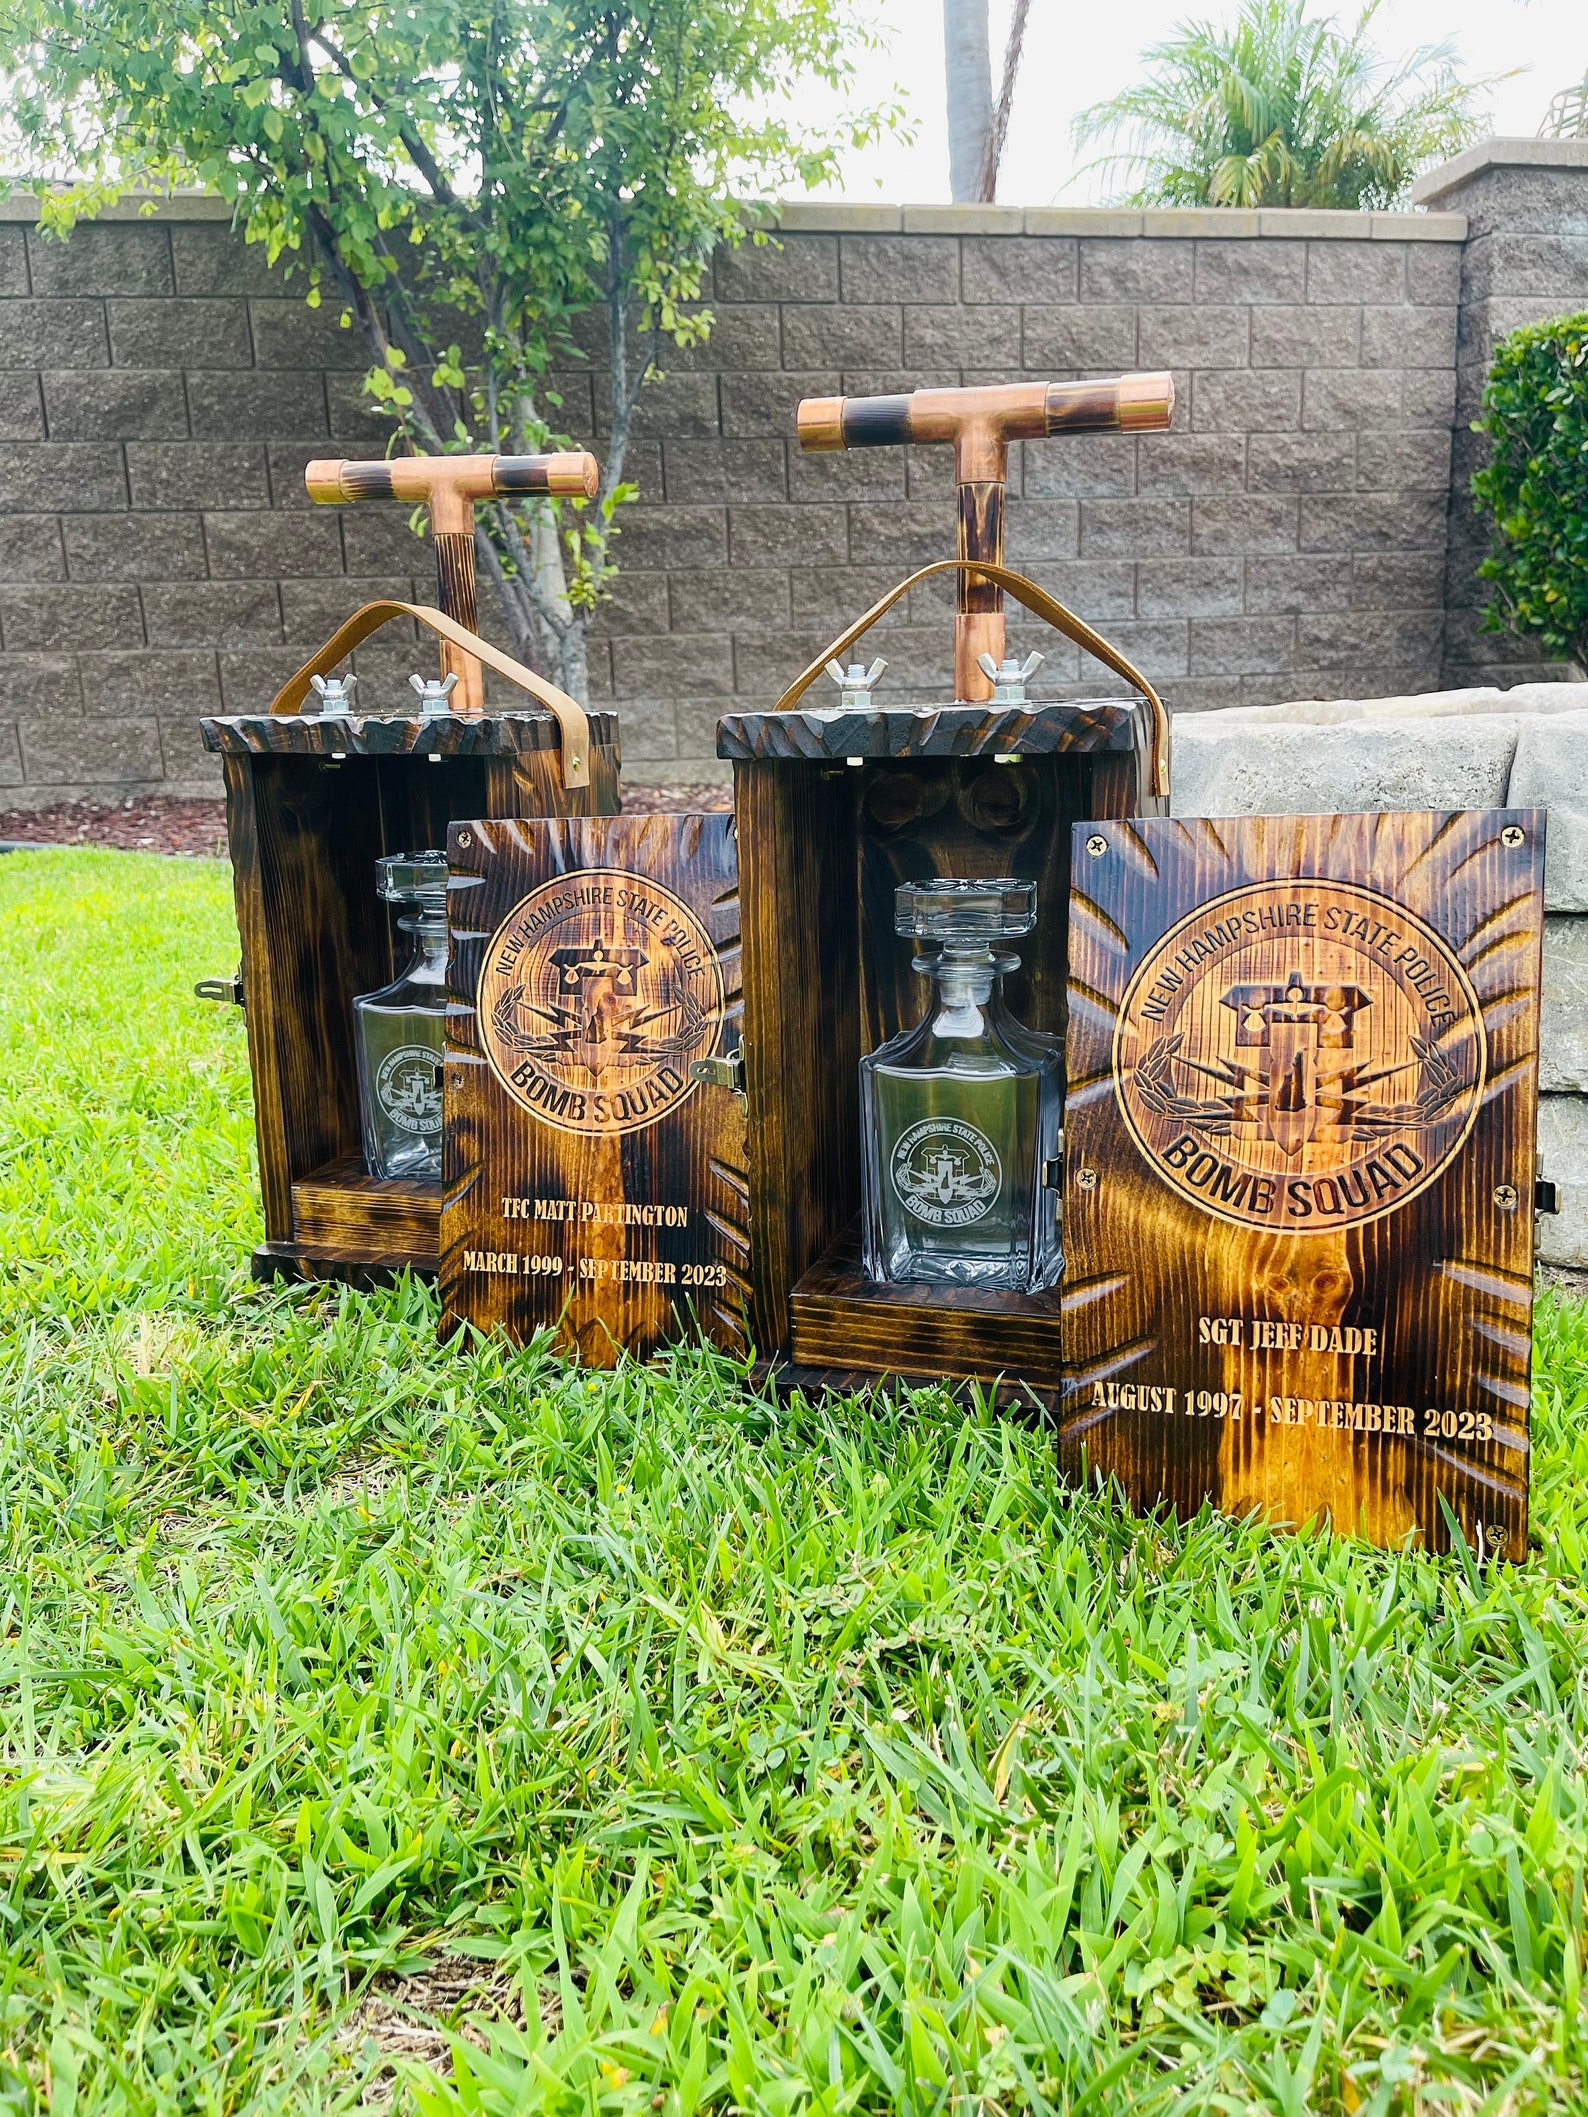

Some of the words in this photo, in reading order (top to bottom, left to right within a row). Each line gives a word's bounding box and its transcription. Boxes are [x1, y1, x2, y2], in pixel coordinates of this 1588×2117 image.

[496, 932, 526, 976] NEW
[522, 887, 613, 939] HAMPSHIRE
[617, 889, 668, 927] STATE
[663, 919, 705, 980] POLICE
[1141, 971, 1183, 1022] NEW
[1180, 903, 1319, 971] HAMPSHIRE
[1324, 906, 1401, 955] STATE
[1393, 946, 1458, 1028] POLICE
[510, 1060, 585, 1121] BOMB
[594, 1066, 685, 1124] SQUAD
[389, 1108, 418, 1130] BOMB
[420, 1114, 443, 1131] SQU
[897, 1142, 911, 1160] NEW
[909, 1123, 952, 1144] HAMPSHIRE
[953, 1124, 977, 1142] STATE
[973, 1138, 995, 1166] POLICE
[1161, 1132, 1279, 1215] BOMB
[1288, 1143, 1424, 1218] SQUAD
[501, 1197, 530, 1219] TFC
[534, 1199, 577, 1222] MATT
[580, 1201, 688, 1228] PARTINGTON
[905, 1195, 942, 1222] BOMB
[944, 1200, 986, 1224] SQUAD
[462, 1250, 518, 1274] MARCH
[522, 1254, 563, 1276] 1999
[579, 1258, 677, 1285] SEPTEMBER
[681, 1264, 727, 1287] 2023
[1198, 1316, 1244, 1346] SGT
[1249, 1319, 1302, 1351] JEFF
[1309, 1325, 1378, 1356] DADE
[1091, 1380, 1178, 1414] AUGUST
[1183, 1389, 1244, 1420] 1997
[1269, 1396, 1416, 1435] SEPTEMBER
[1423, 1408, 1494, 1442] 2023
